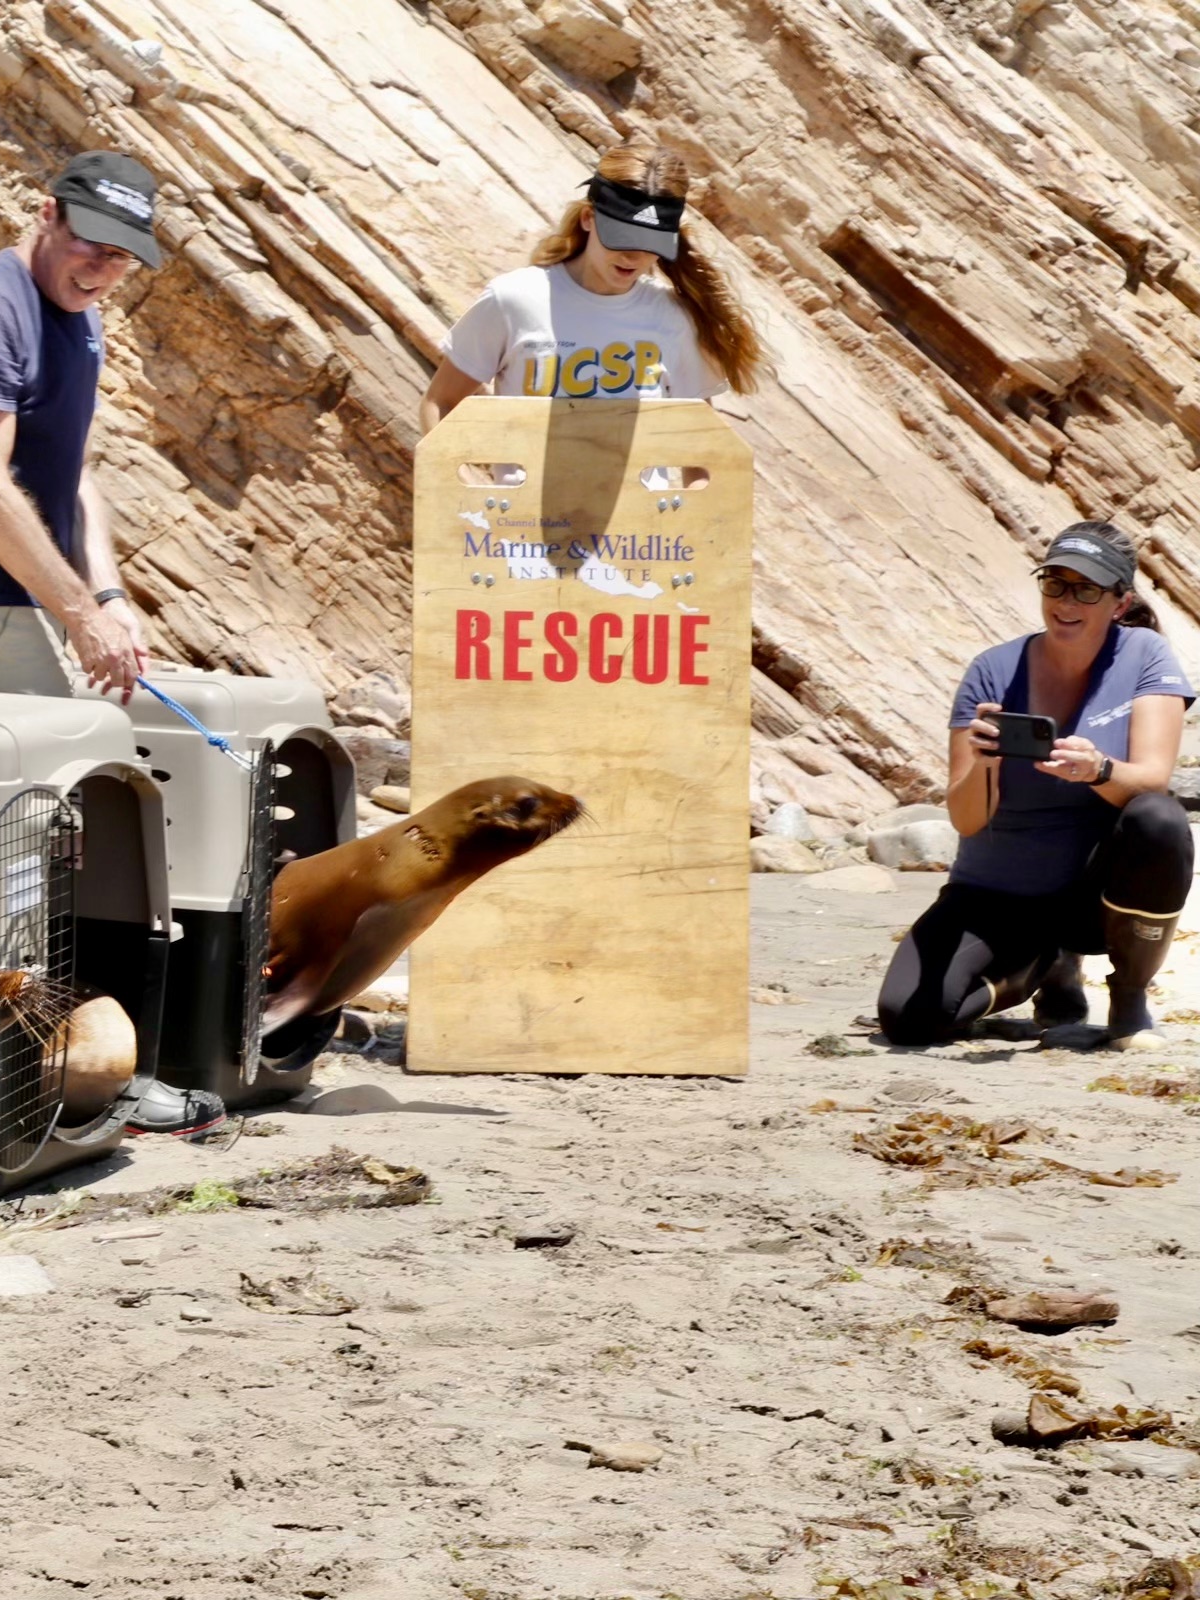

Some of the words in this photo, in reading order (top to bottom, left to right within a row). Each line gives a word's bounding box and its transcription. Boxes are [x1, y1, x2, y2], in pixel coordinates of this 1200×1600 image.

[523, 340, 662, 398] UCSB
[496, 517, 536, 528] Channel
[539, 518, 572, 528] Islands
[464, 531, 560, 559] Marine
[567, 541, 586, 560] &
[589, 534, 695, 561] Wildlife
[507, 566, 652, 582] INSTITUTE
[454, 609, 711, 686] RESCUE
